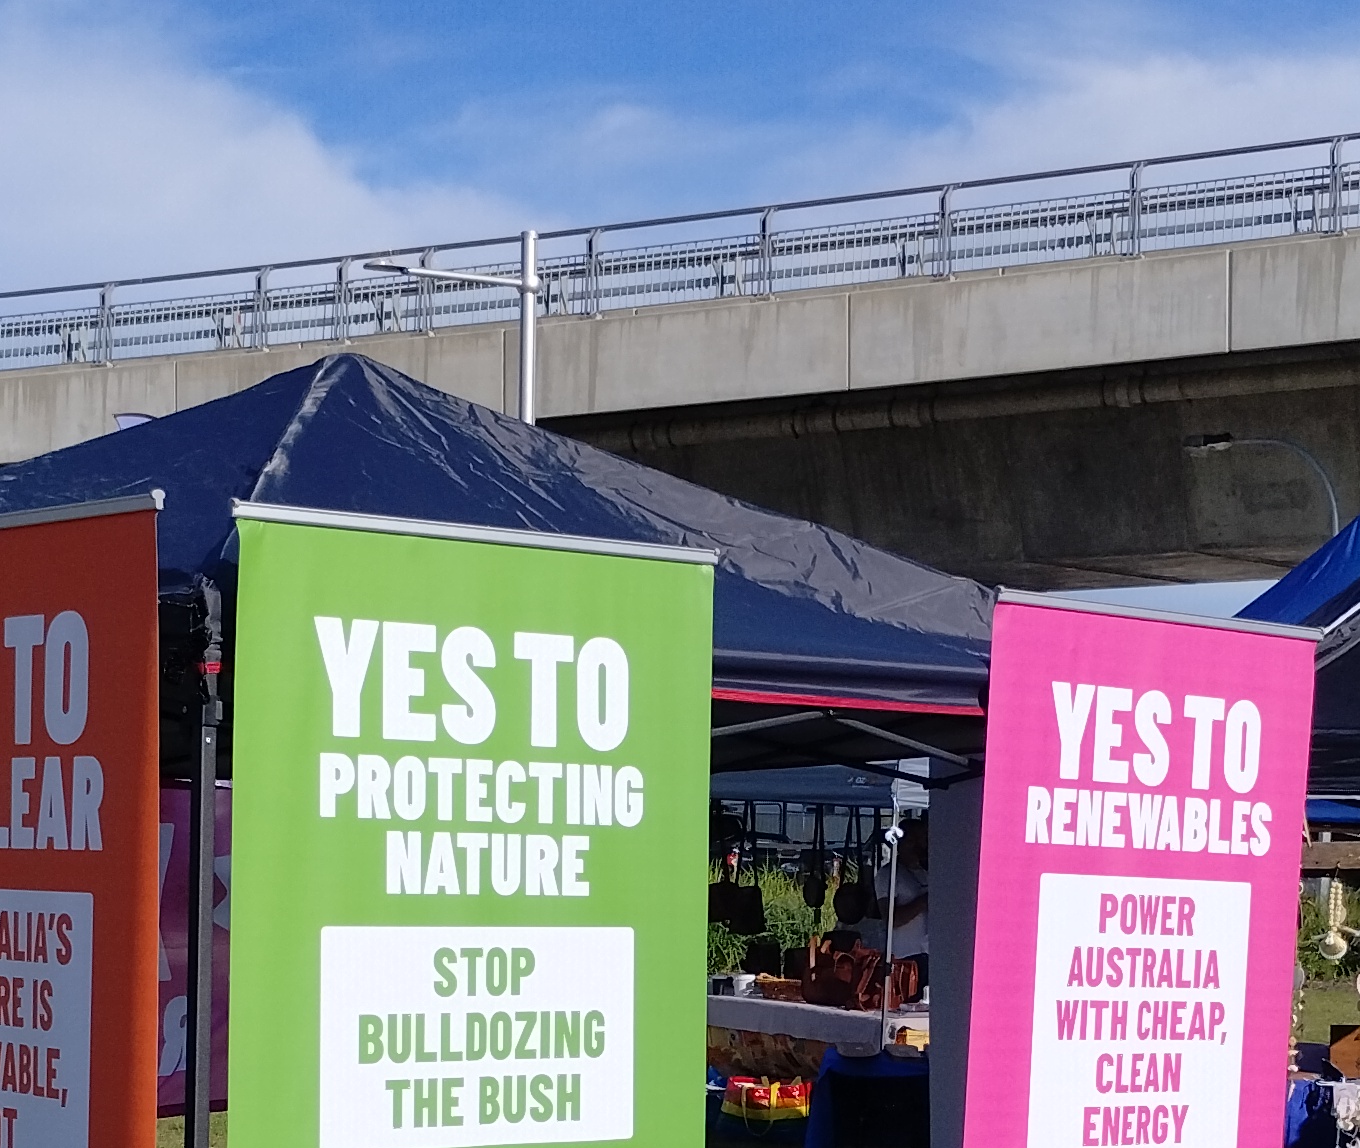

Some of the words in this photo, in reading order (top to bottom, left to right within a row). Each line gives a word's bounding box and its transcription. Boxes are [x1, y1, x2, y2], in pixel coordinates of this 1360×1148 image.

[4, 610, 89, 746] TO
[313, 615, 497, 745] YES
[513, 631, 630, 752] TO
[1051, 680, 1172, 787] YES
[1183, 694, 1262, 794] TO
[319, 752, 645, 828] PROTECTING
[1024, 785, 1274, 857] RENEWABLES
[386, 830, 590, 897] NATURE
[1098, 893, 1196, 936] POWER
[433, 946, 536, 998] STOP
[1066, 945, 1220, 989] AUSTRALIA
[33, 979, 54, 1032] IS
[1056, 999, 1127, 1041] WITH
[1136, 1000, 1227, 1046] CHEAP,
[358, 1009, 606, 1065] BULLDOZING
[385, 1076, 464, 1129] THE
[478, 1073, 581, 1126] BUSH
[1095, 1053, 1182, 1094] CLEAN
[1082, 1104, 1189, 1147] ENERGY
